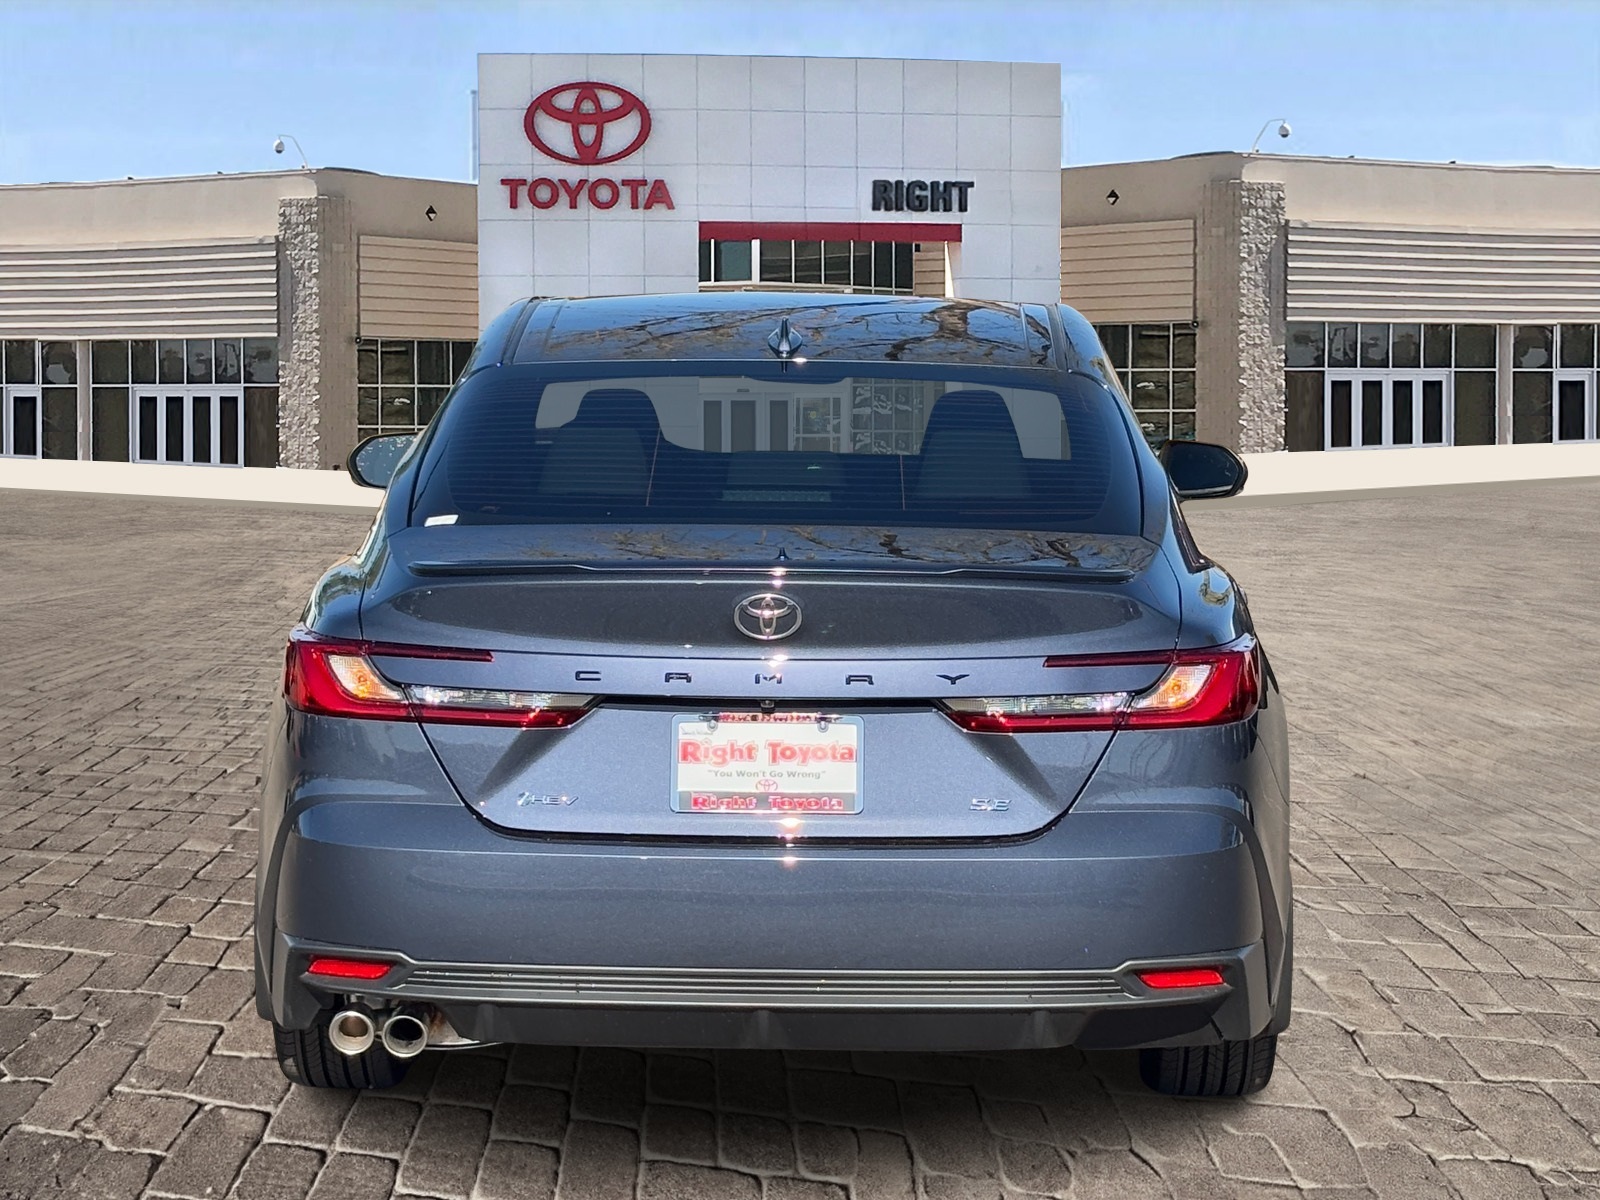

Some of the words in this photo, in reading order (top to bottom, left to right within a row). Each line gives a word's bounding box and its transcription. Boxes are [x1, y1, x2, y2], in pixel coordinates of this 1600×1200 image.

[500, 178, 675, 210] TOYOTA
[871, 179, 975, 213] RIGHT
[575, 670, 970, 687] CAMRY
[679, 738, 758, 767] Right
[764, 738, 857, 766] Toyota
[736, 769, 766, 778] Won't
[769, 770, 783, 778] Go
[691, 793, 757, 810] Right
[768, 794, 843, 811] Toyota
[969, 797, 1011, 811] SE
